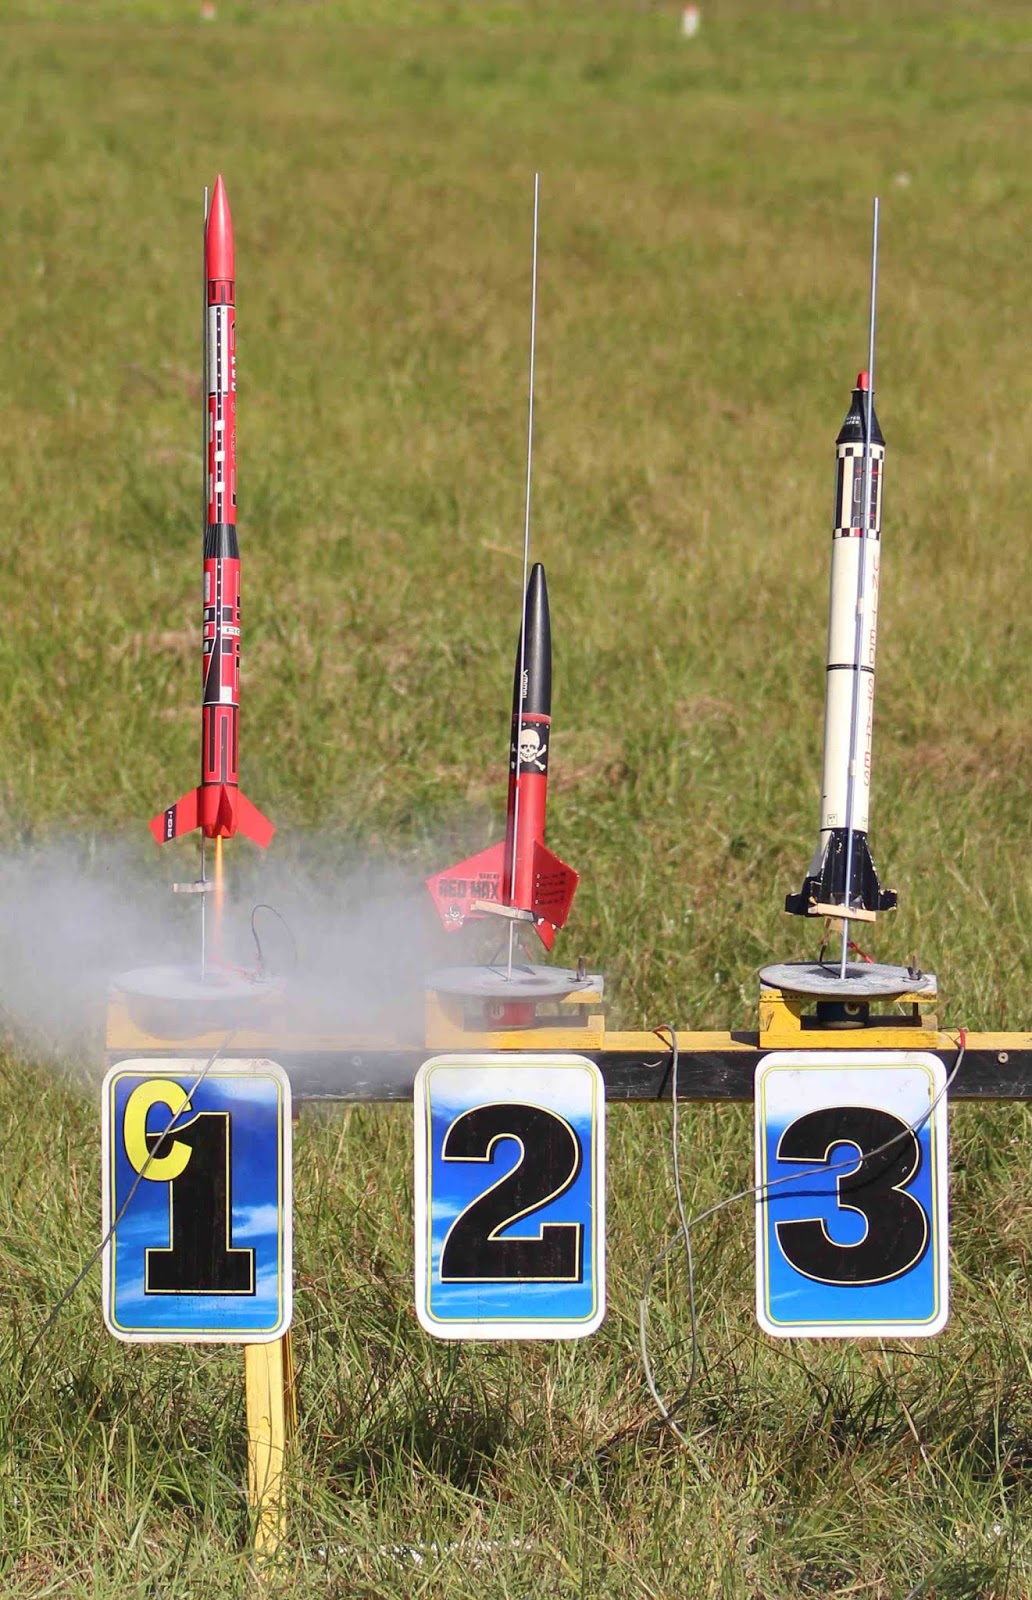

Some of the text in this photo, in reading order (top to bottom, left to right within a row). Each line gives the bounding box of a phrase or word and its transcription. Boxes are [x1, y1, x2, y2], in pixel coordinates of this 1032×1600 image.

[863, 553, 881, 788] UNITED STATES
[438, 879, 499, 900] RED MAX
[123, 1079, 193, 1181] C
[145, 1111, 256, 1296] 1
[441, 1101, 582, 1283] 2
[774, 1105, 930, 1288] 3
